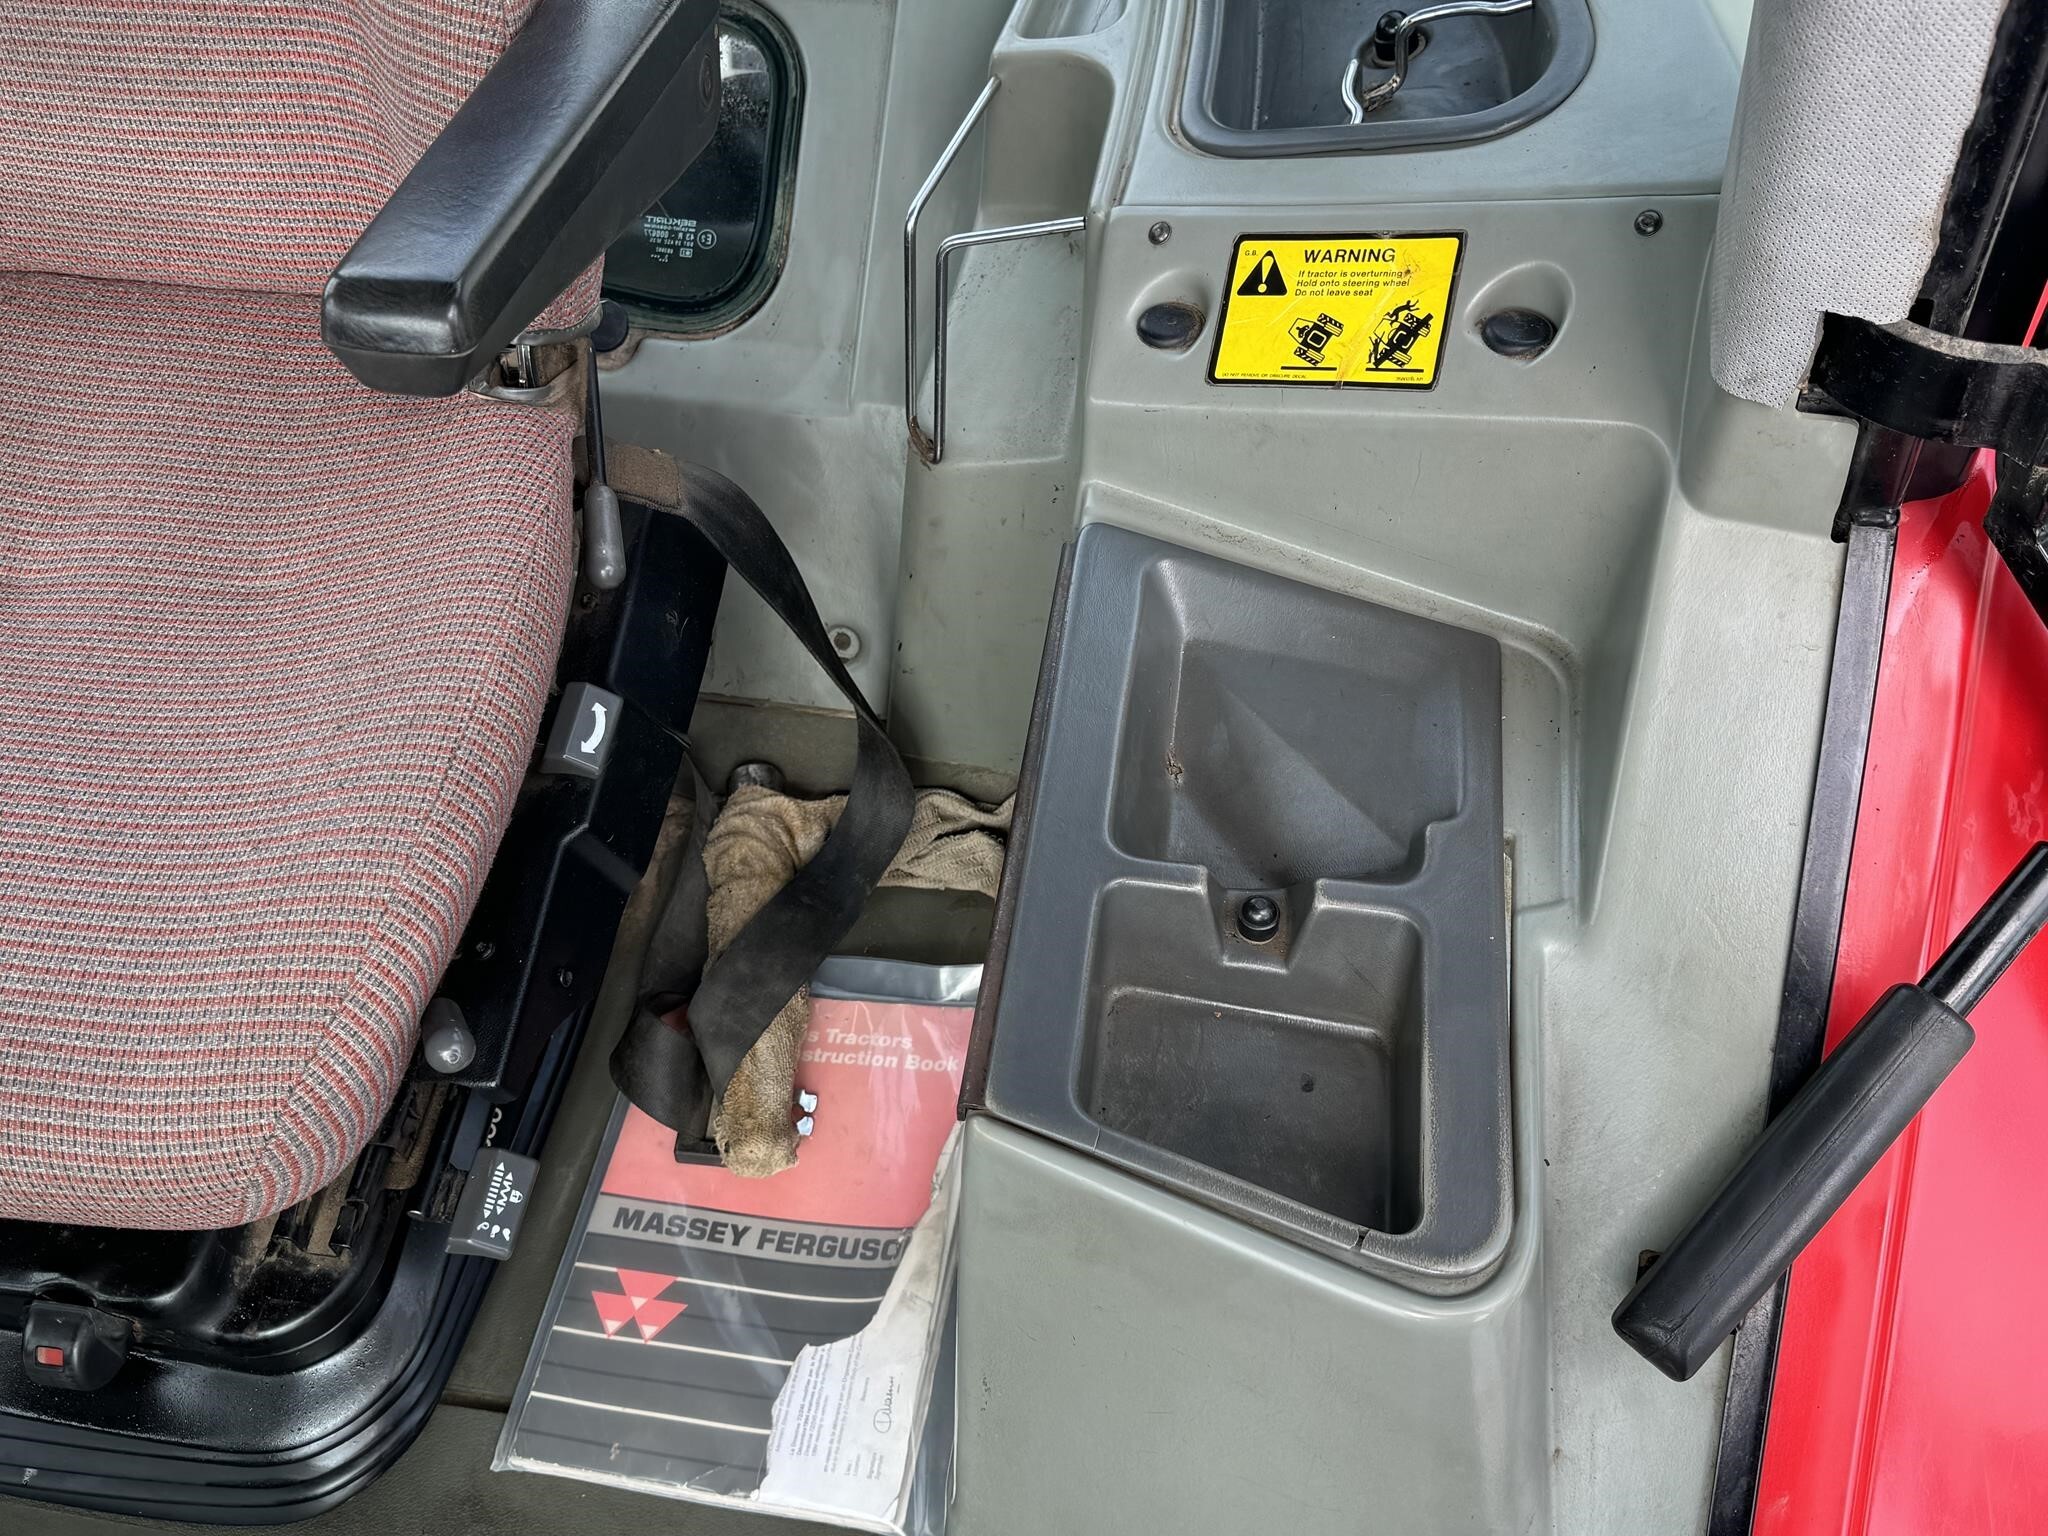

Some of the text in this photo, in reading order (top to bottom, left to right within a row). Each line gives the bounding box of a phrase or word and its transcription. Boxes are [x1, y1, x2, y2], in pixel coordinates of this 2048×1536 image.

[1304, 248, 1396, 263] WARNING
[1342, 280, 1380, 288] steering
[1383, 279, 1410, 287] wheel
[1350, 270, 1403, 279] overturning
[826, 1028, 913, 1049] Tractors
[802, 1048, 959, 1072] struction Book
[612, 1207, 752, 1247] MASSEY
